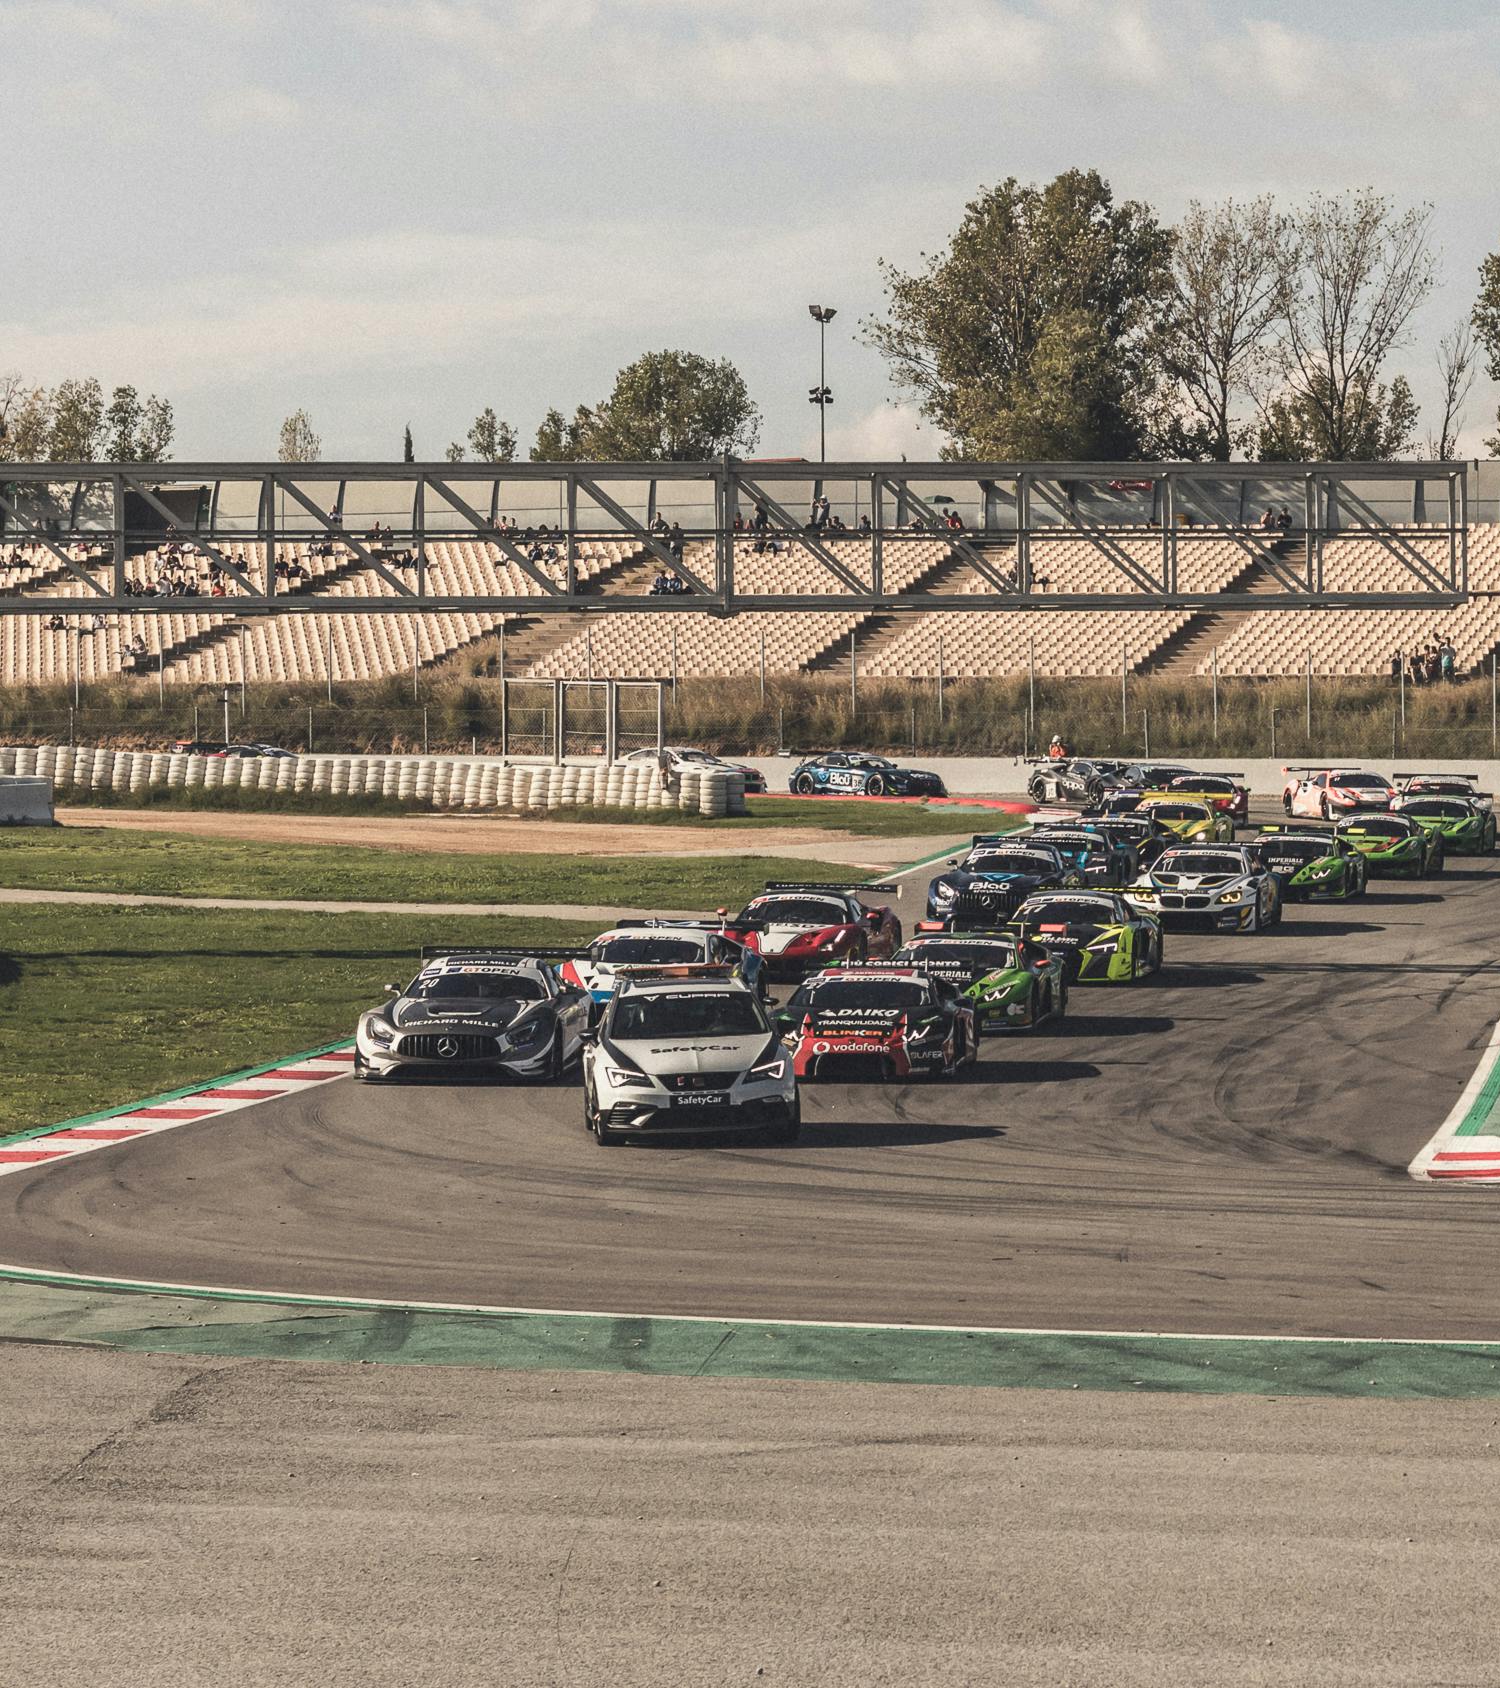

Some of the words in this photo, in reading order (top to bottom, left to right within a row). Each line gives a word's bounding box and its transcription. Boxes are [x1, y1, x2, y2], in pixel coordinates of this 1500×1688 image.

[1061, 778, 1084, 791] oppo
[931, 970, 973, 979] PERIALE
[419, 979, 440, 989] 20
[837, 1008, 900, 1017] DAIKO
[405, 1018, 459, 1028] RICHARD
[461, 1018, 499, 1028] MILLE
[650, 1045, 740, 1054] SafetyCar
[677, 1095, 722, 1105] SafetyCar
